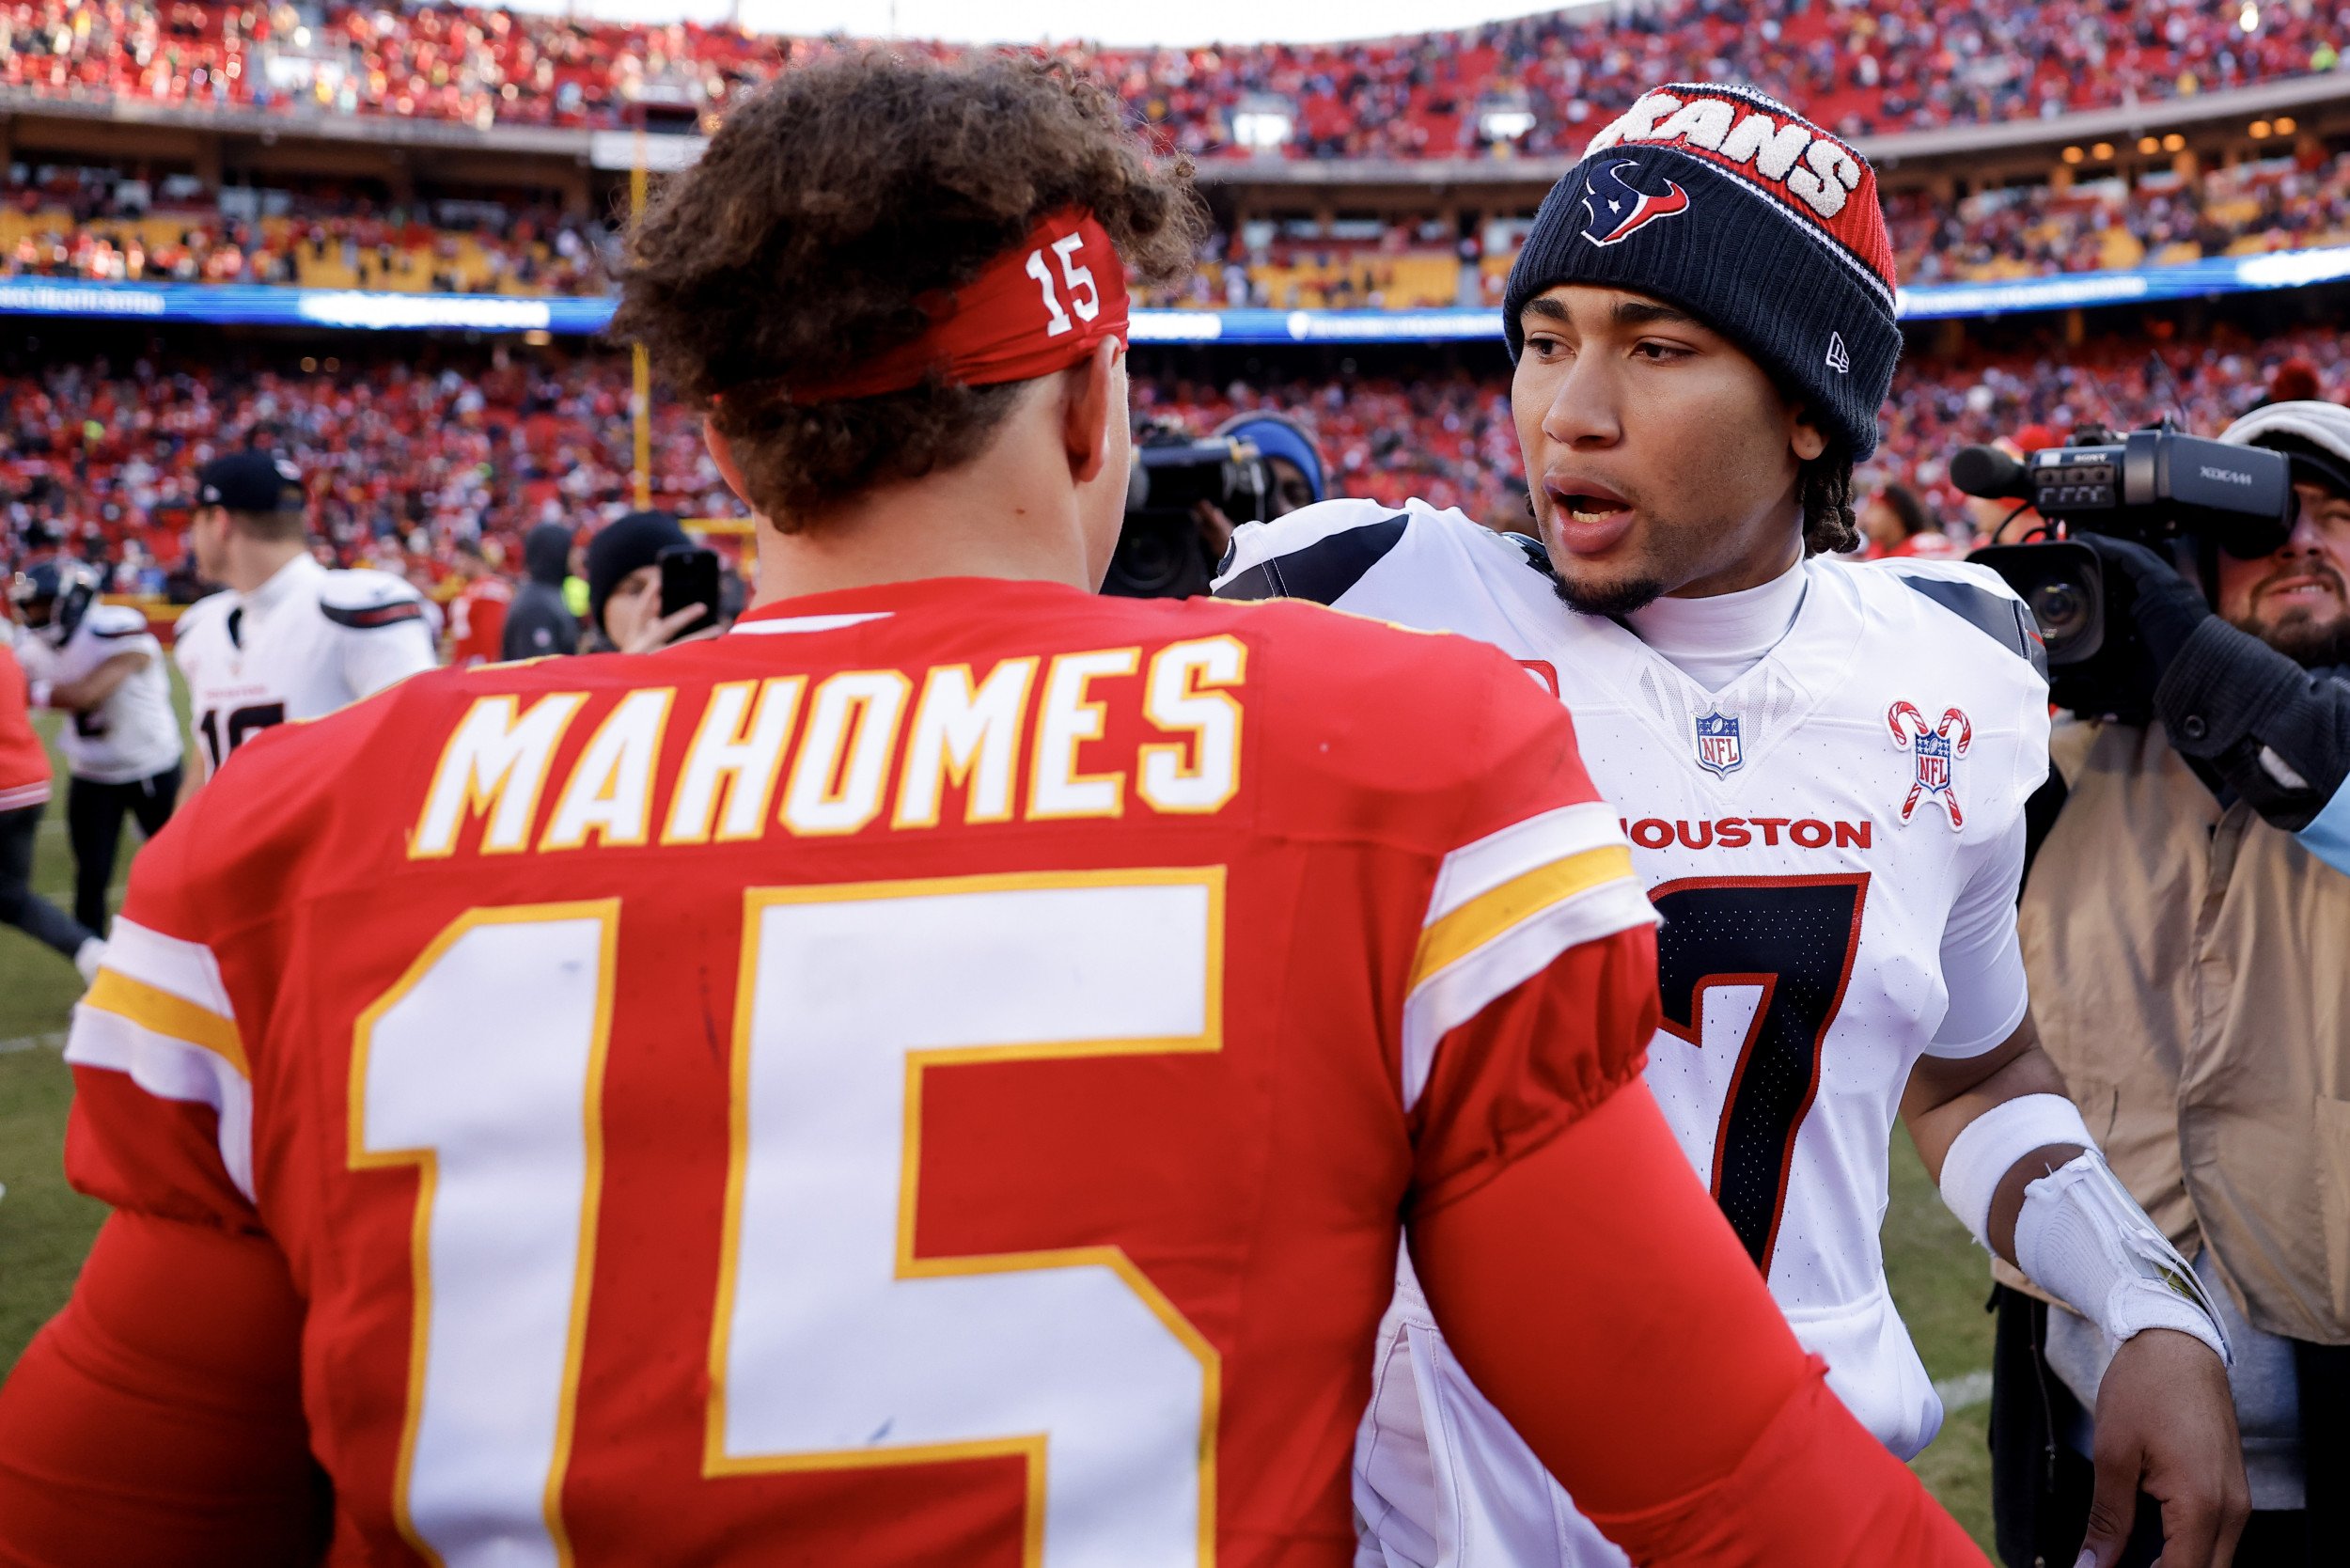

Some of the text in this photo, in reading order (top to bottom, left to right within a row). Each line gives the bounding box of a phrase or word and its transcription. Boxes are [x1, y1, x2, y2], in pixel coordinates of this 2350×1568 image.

[1579, 93, 1860, 219] XANS
[1026, 231, 1100, 337] 15
[407, 635, 1247, 859] MAHOMES
[1702, 738, 1737, 765] NFL
[1919, 756, 1947, 786] NFL
[1647, 872, 1871, 1286] 7
[348, 865, 1227, 1568] 15
